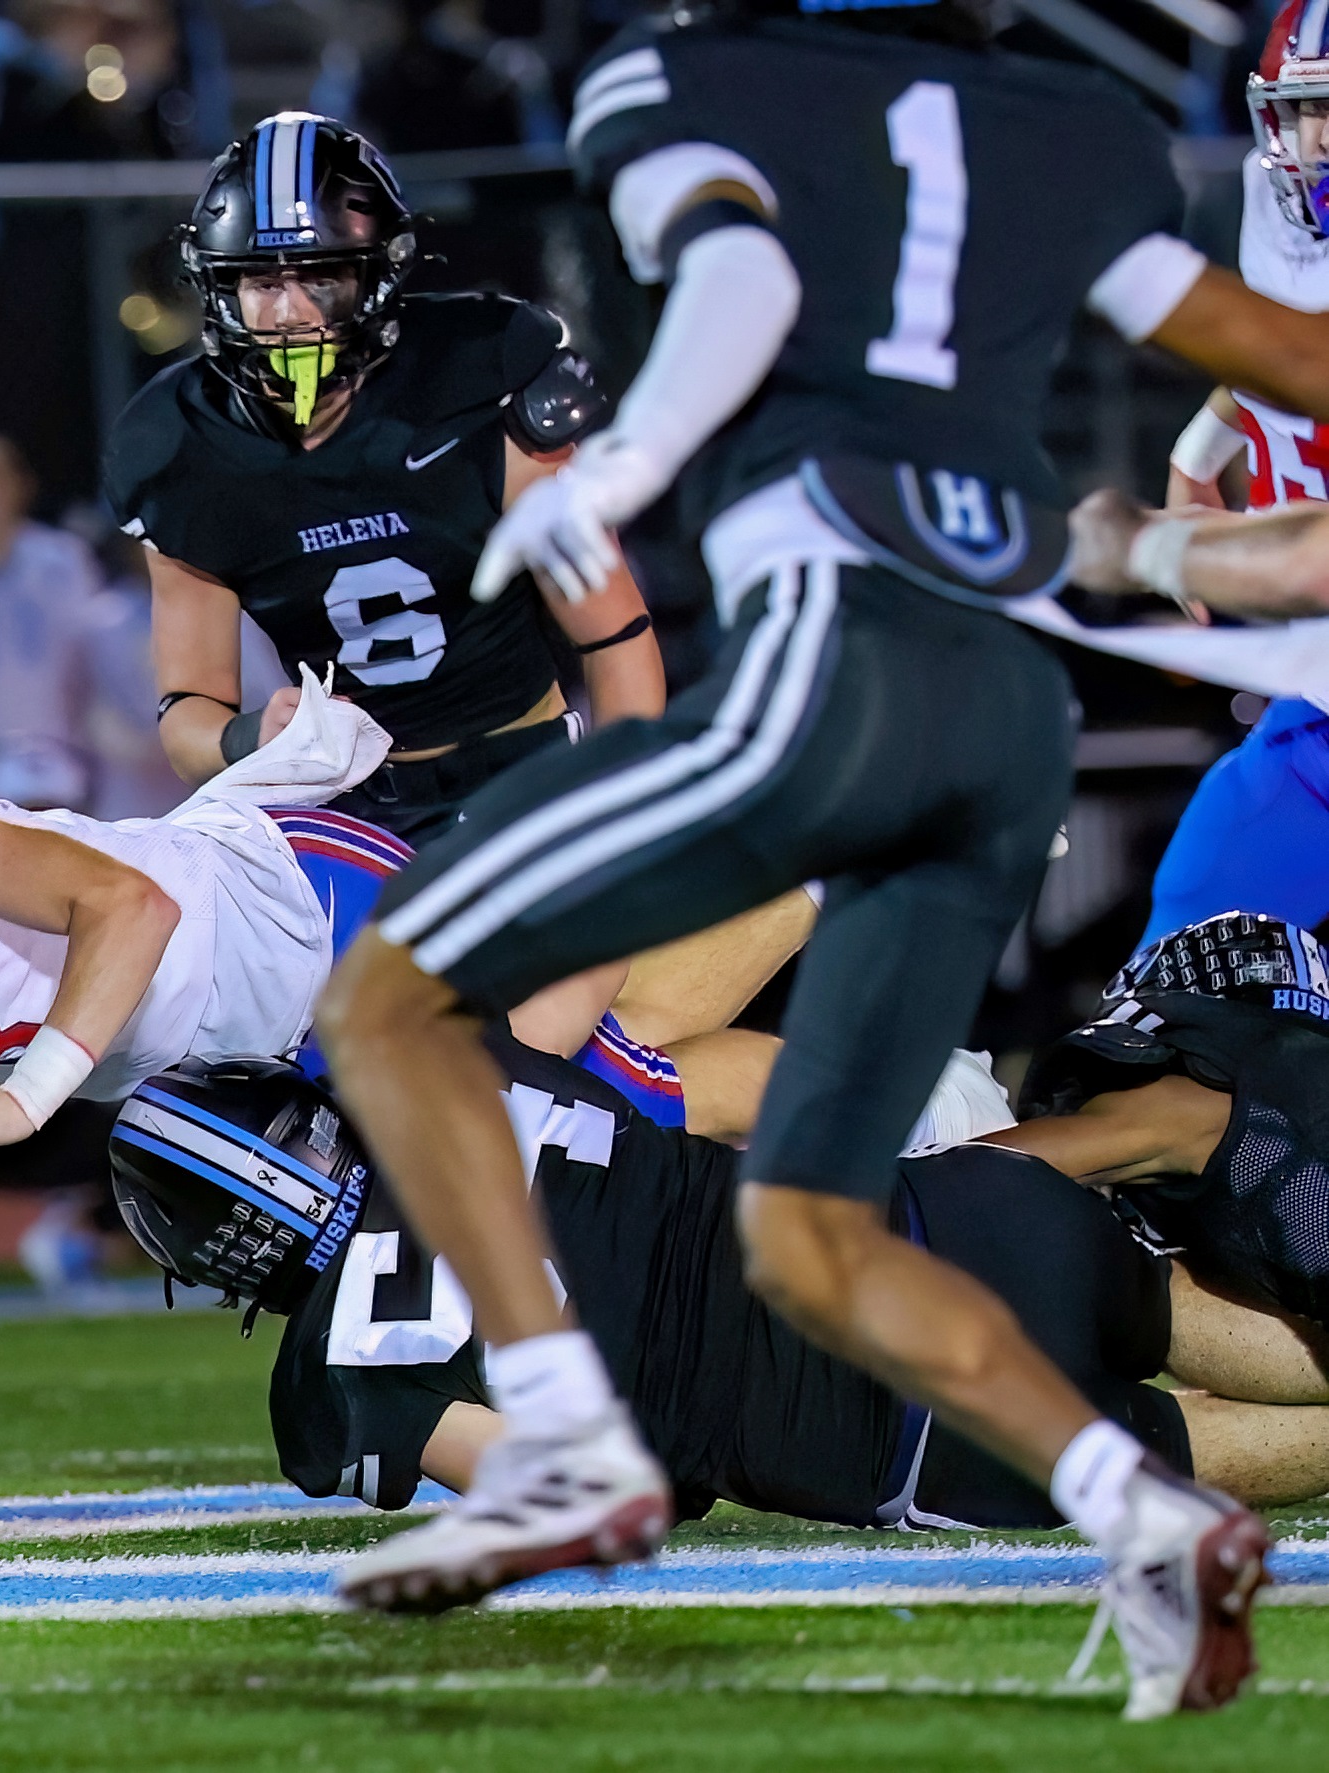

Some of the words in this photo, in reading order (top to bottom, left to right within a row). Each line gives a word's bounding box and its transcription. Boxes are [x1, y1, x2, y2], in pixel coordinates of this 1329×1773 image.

[866, 80, 969, 392] 1
[298, 512, 410, 553] HELENA
[930, 470, 996, 543] H
[323, 556, 448, 687] 6
[306, 1194, 328, 1219] 54
